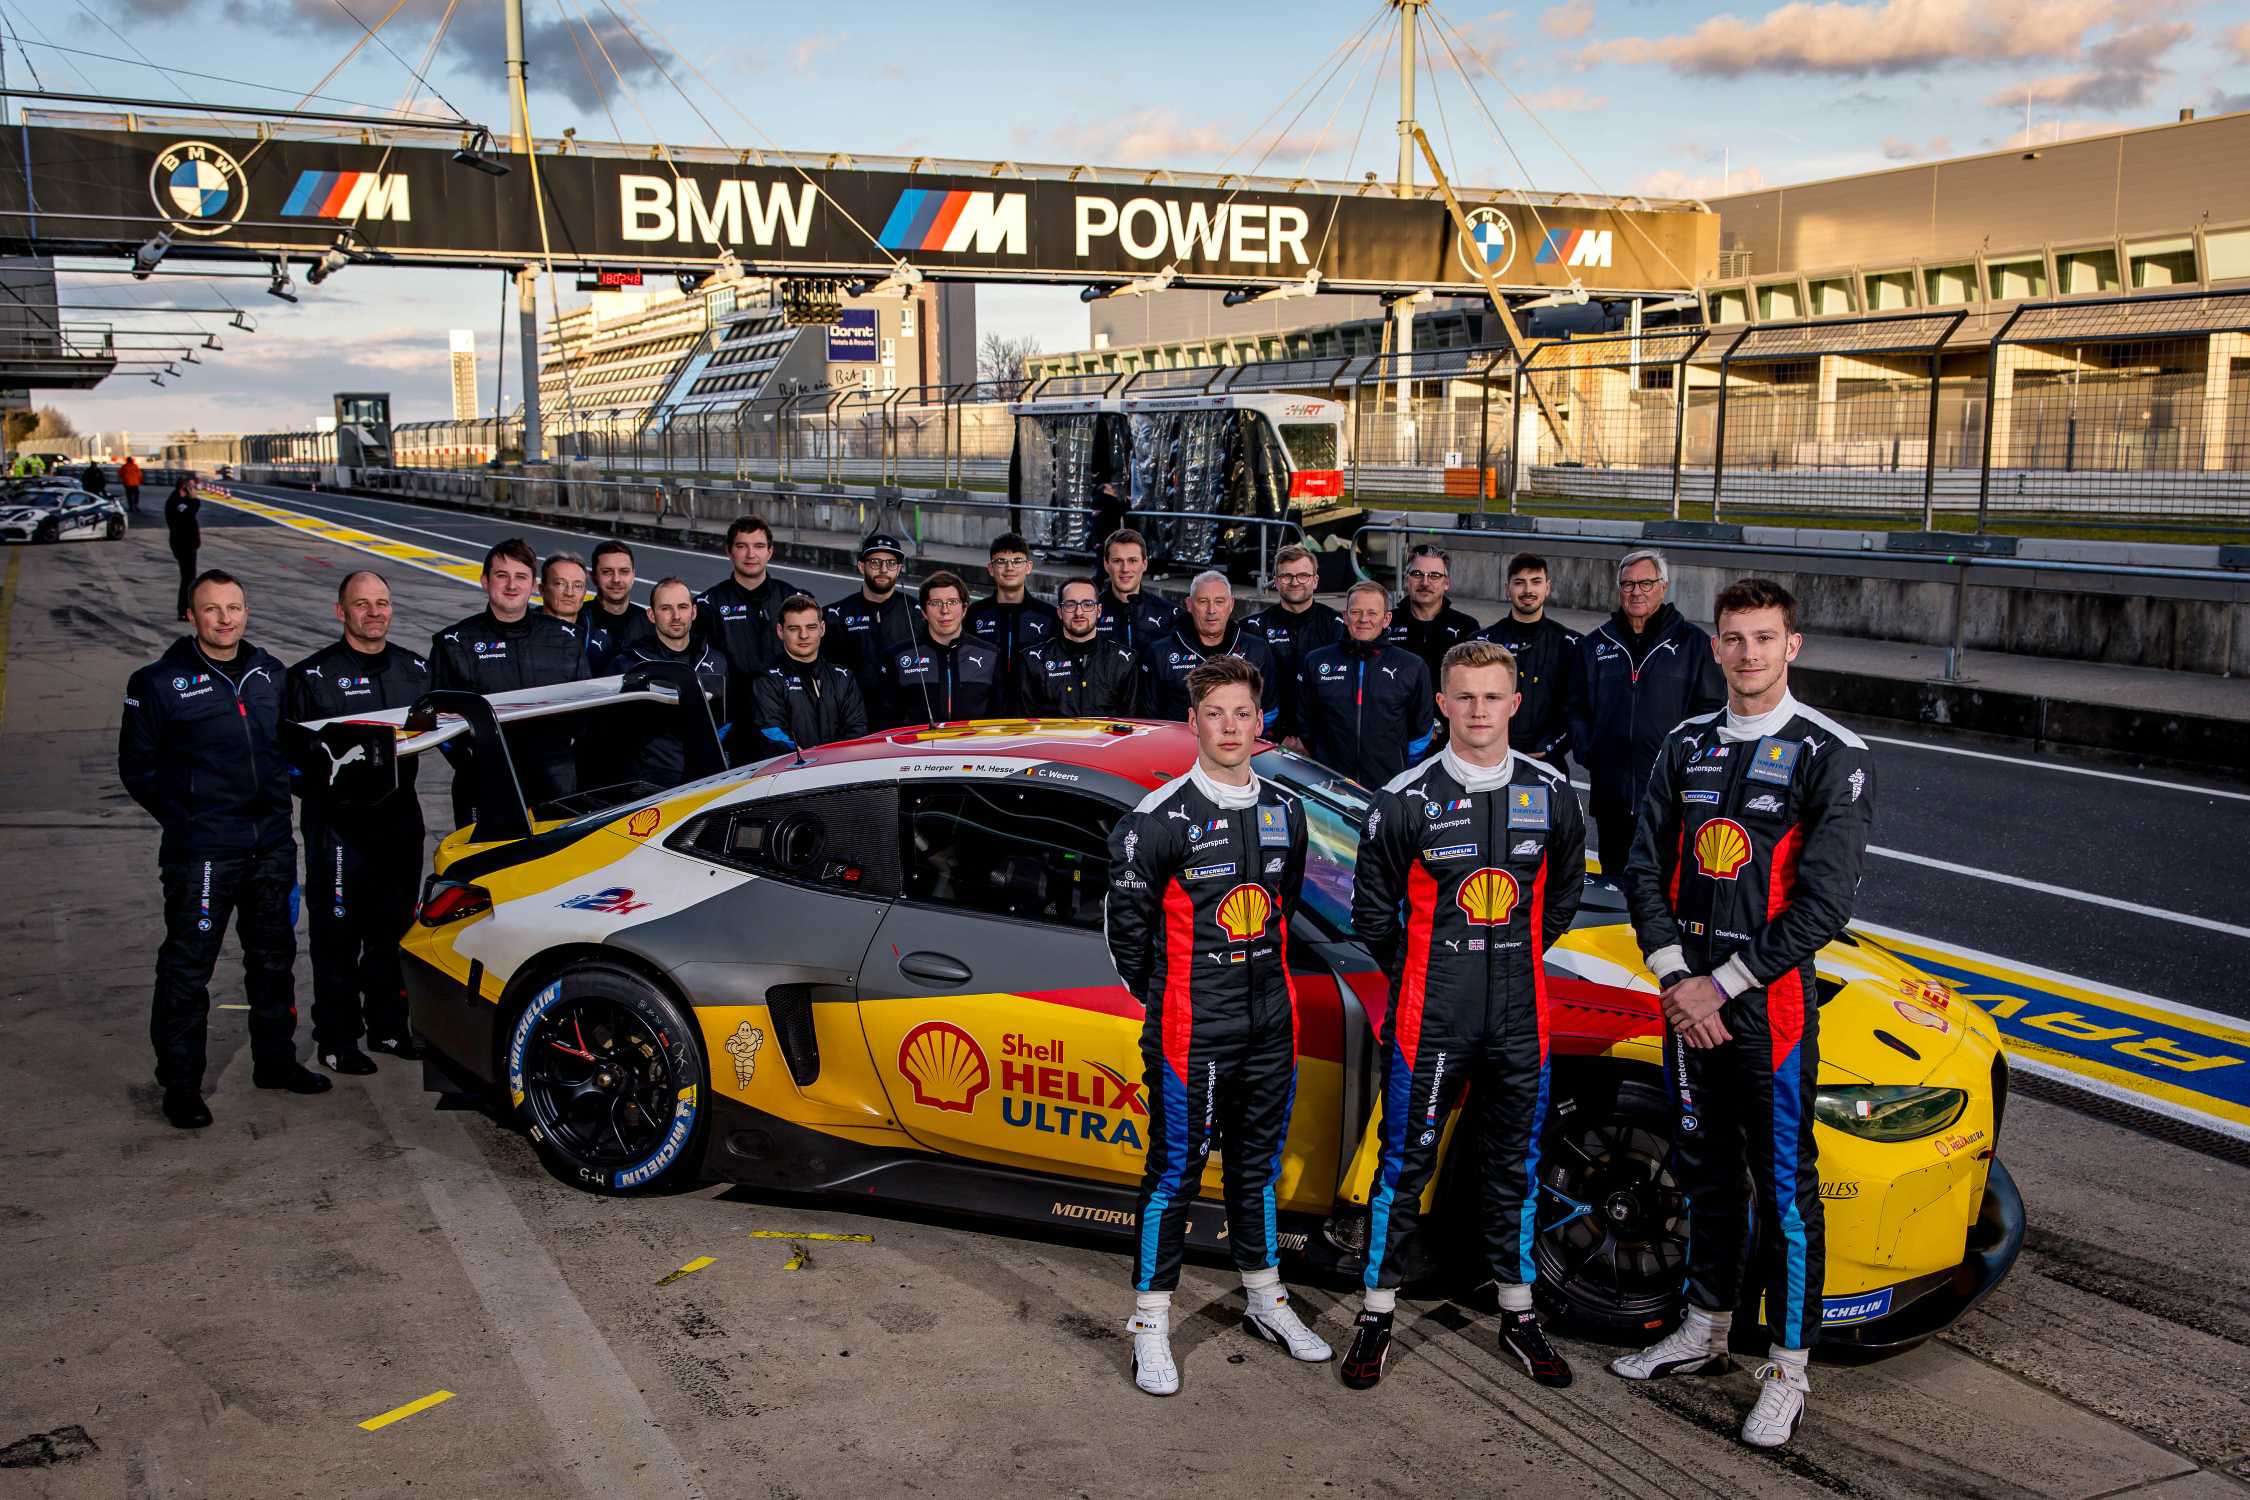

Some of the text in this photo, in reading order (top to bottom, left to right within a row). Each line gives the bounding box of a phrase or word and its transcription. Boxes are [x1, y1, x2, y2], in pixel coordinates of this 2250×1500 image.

[618, 173, 818, 248] BMW
[1075, 195, 1311, 265] POWER
[829, 325, 874, 337] Dorint
[180, 685, 214, 699] Motorsport
[924, 764, 954, 773] Harper
[976, 764, 986, 772] M.
[988, 765, 1015, 774] Hesse
[1049, 770, 1079, 782] Weerts
[1686, 764, 1723, 774] Motorsport
[1429, 816, 1472, 832] Motorsport
[1192, 837, 1229, 852] Motorsport
[1438, 846, 1473, 856] MICHELIN
[202, 860, 212, 897] Motorspo
[1200, 865, 1231, 876] MICHELIN
[1131, 879, 1147, 889] trim
[1715, 929, 1738, 939] Charles
[511, 986, 556, 1070] MICHELIN
[1001, 1033, 1064, 1064] Shell
[1675, 1033, 1689, 1087] Motorsport
[1000, 1059, 1147, 1116] HELIX
[1206, 1060, 1216, 1113] Motorsport
[1428, 1052, 1447, 1104] Motorsport
[1002, 1097, 1143, 1150] ULTRA
[622, 1120, 688, 1186] MICHELIN
[1822, 1299, 1883, 1319] ICHELIN
